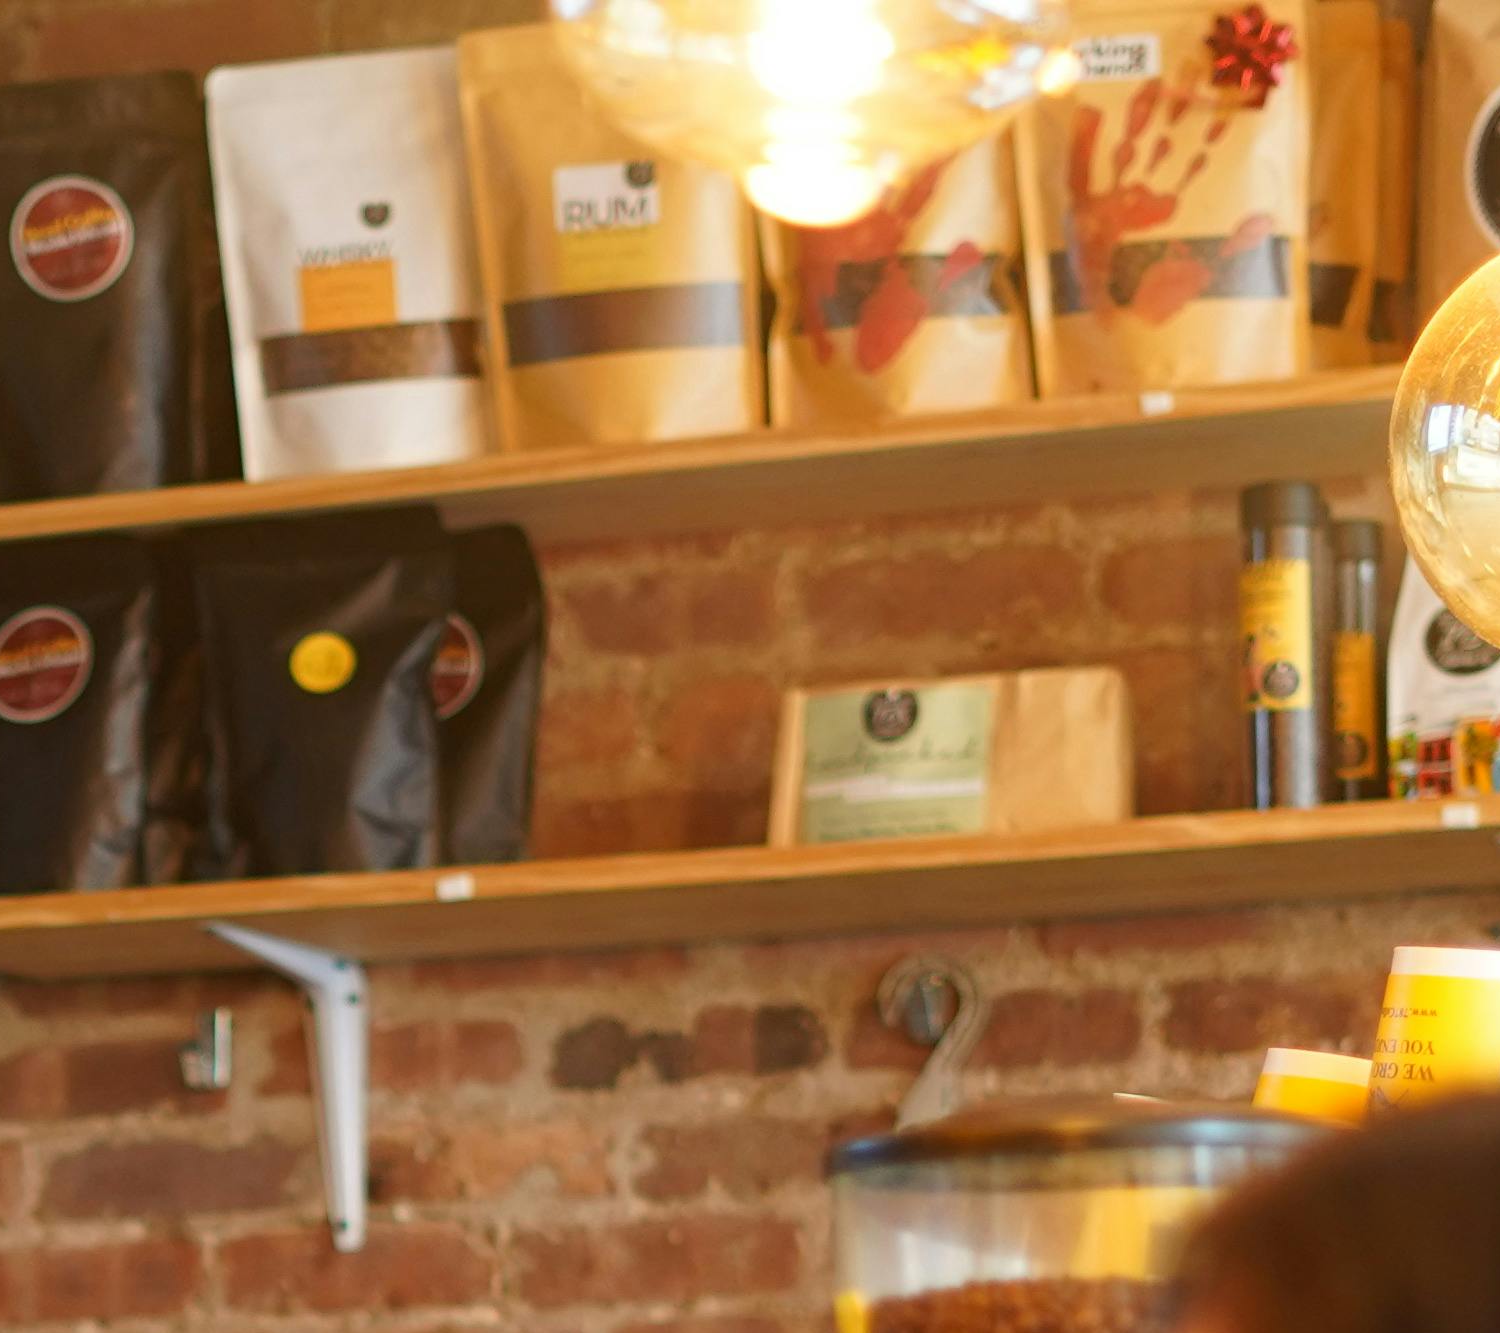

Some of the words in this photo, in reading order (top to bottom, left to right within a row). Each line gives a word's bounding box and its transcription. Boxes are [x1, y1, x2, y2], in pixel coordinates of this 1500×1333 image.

[563, 196, 648, 230] RUM
[1400, 1039, 1435, 1055] YOU
[1404, 1063, 1435, 1081] WE
